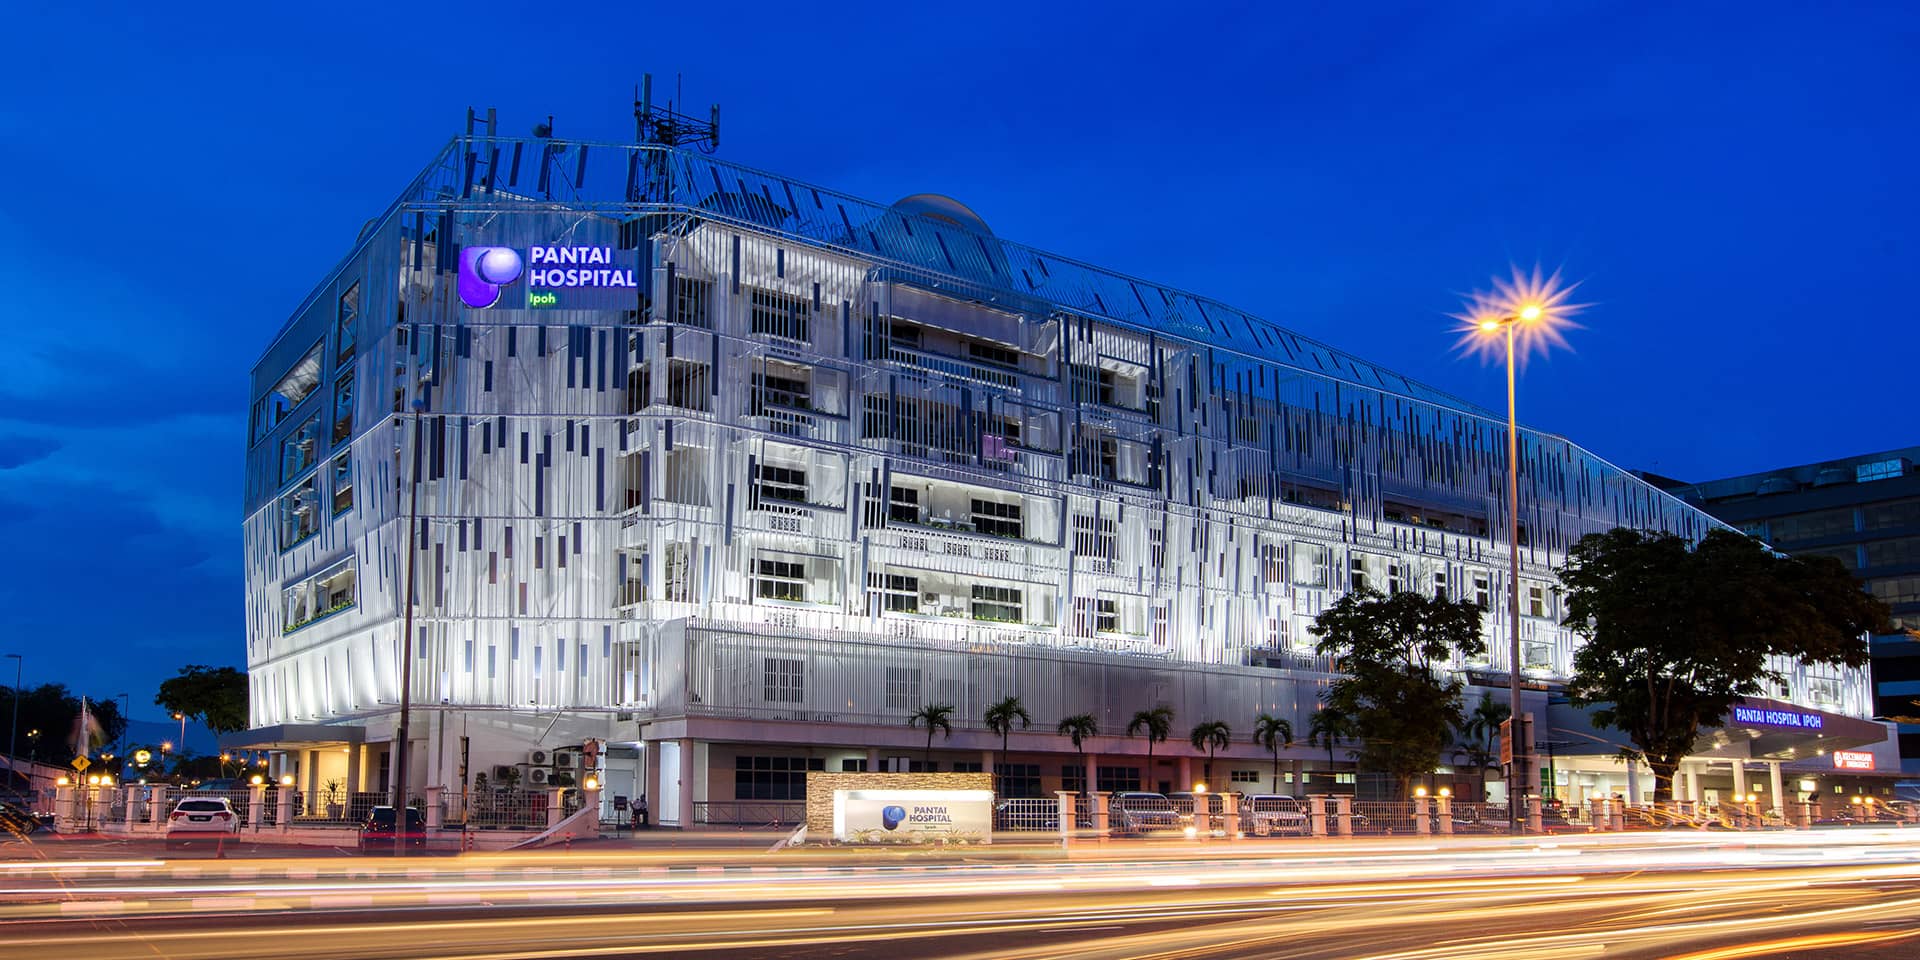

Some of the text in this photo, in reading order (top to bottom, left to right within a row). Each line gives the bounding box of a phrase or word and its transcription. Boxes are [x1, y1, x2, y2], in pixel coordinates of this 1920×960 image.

[531, 247, 611, 264] PANTAI
[530, 269, 637, 287] HOSPITAL
[530, 293, 556, 306] Ipoh
[1736, 708, 1822, 728] PANTAI HOSPITAL IPOH
[909, 814, 952, 822] HOSPITAL
